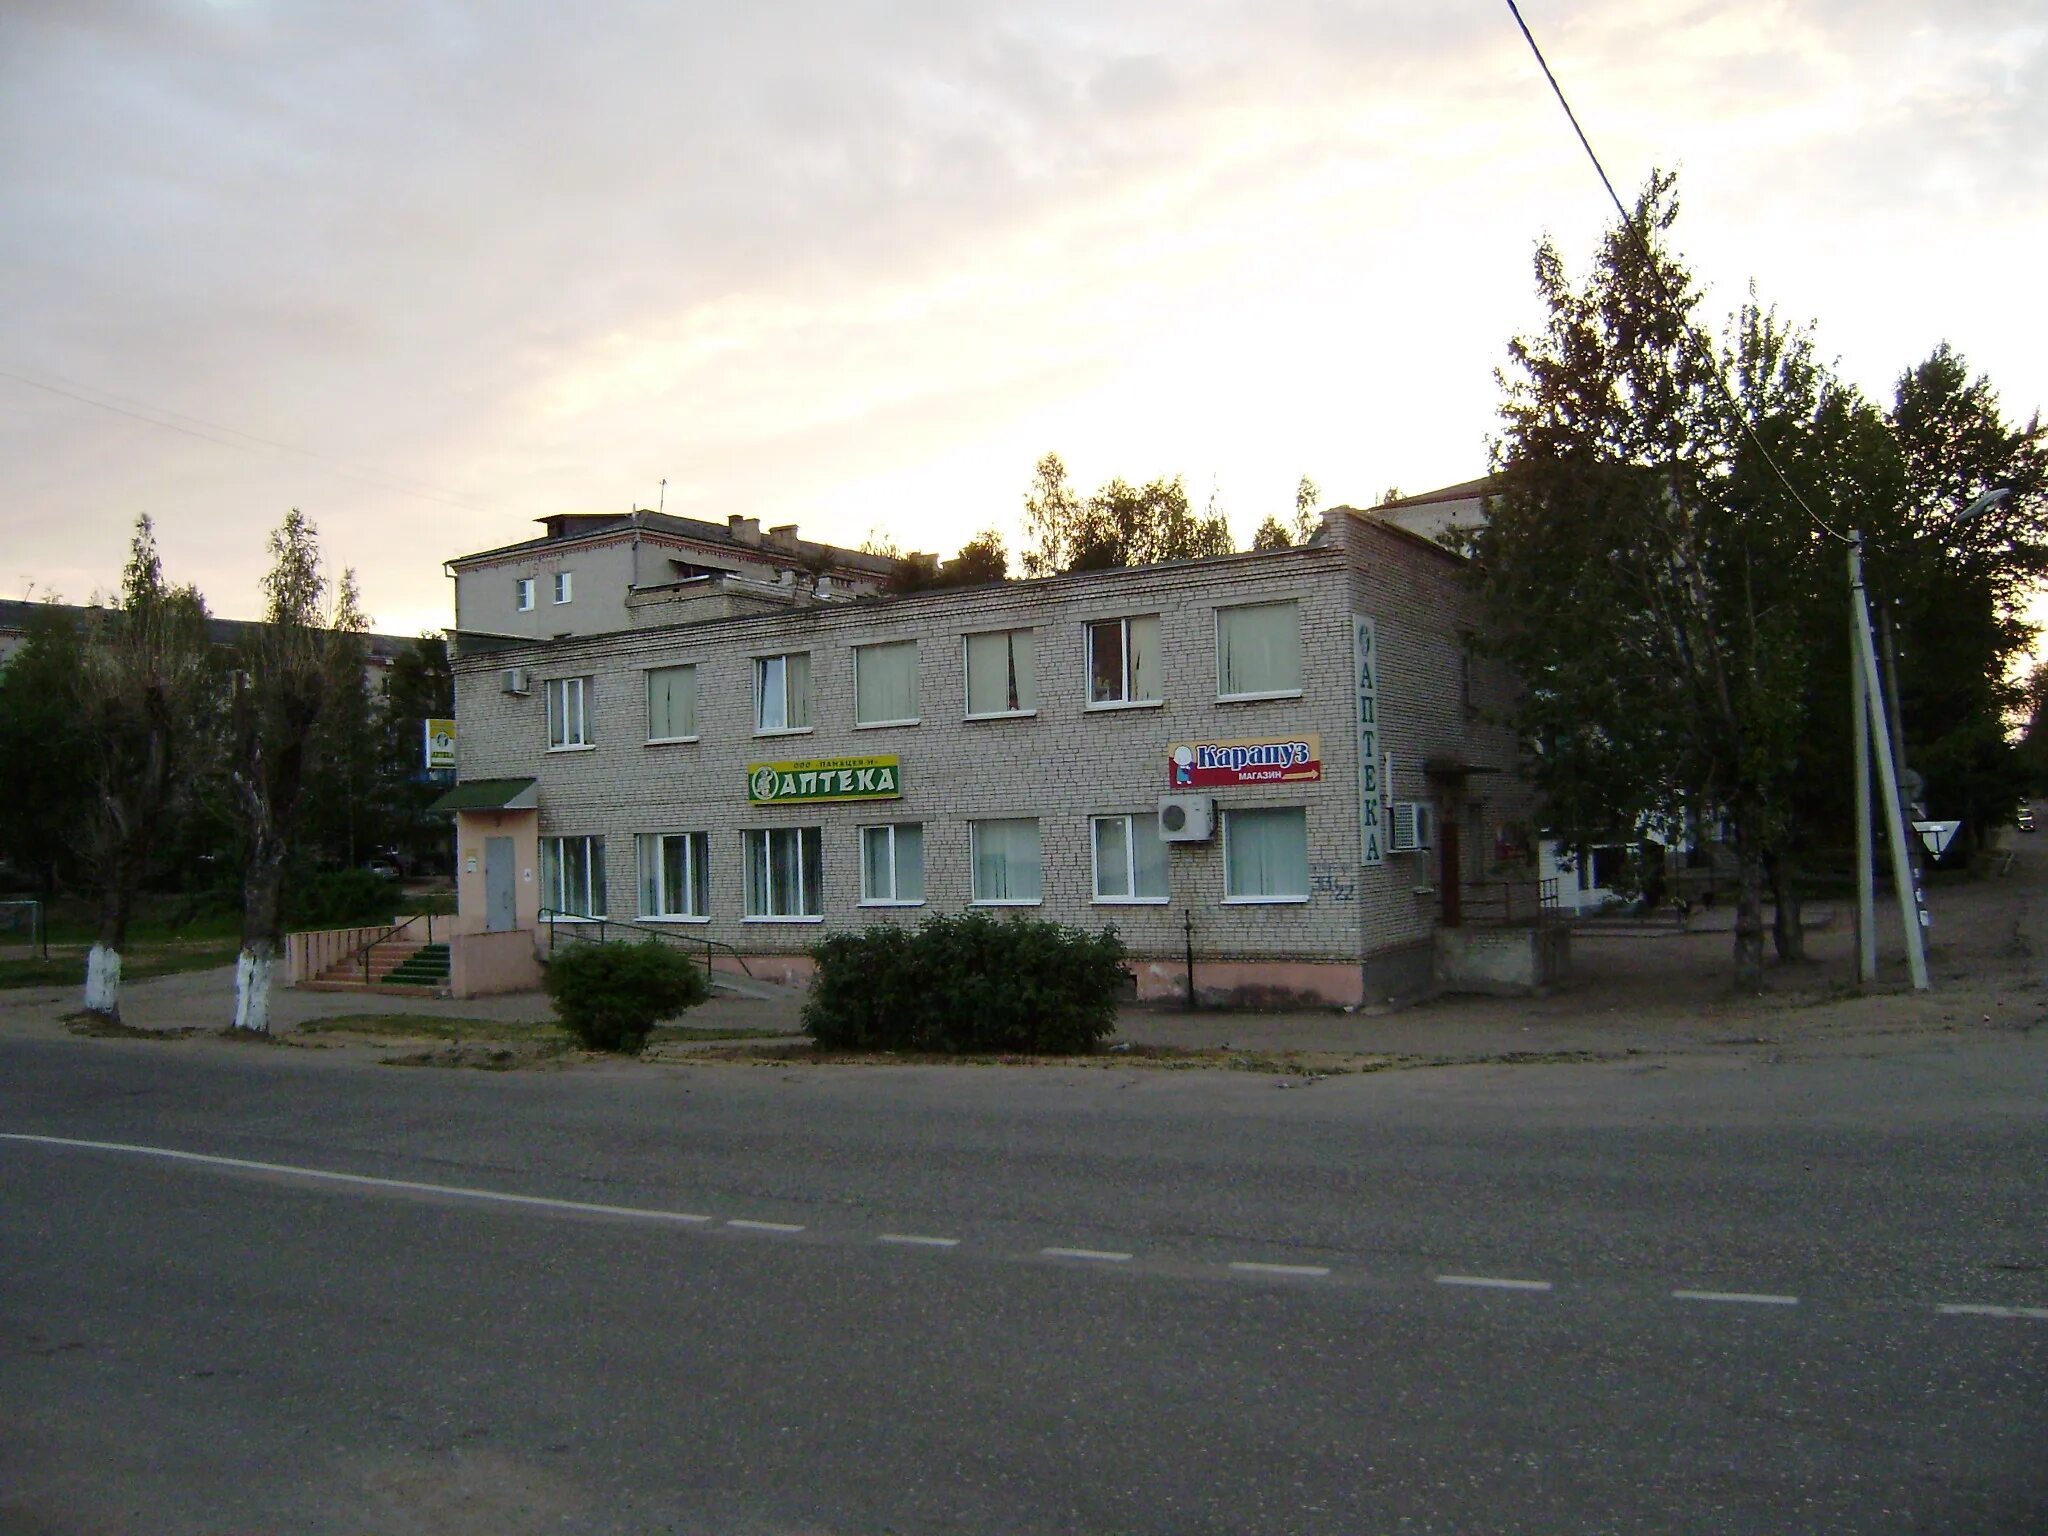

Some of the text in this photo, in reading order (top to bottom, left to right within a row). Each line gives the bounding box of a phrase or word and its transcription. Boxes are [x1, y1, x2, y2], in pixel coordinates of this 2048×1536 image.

[1196, 741, 1309, 771] Карапуз
[1360, 662, 1380, 861] АПТЕКА
[780, 768, 895, 796] АПТЕКА
[1238, 771, 1282, 781] МАГАЗИН
